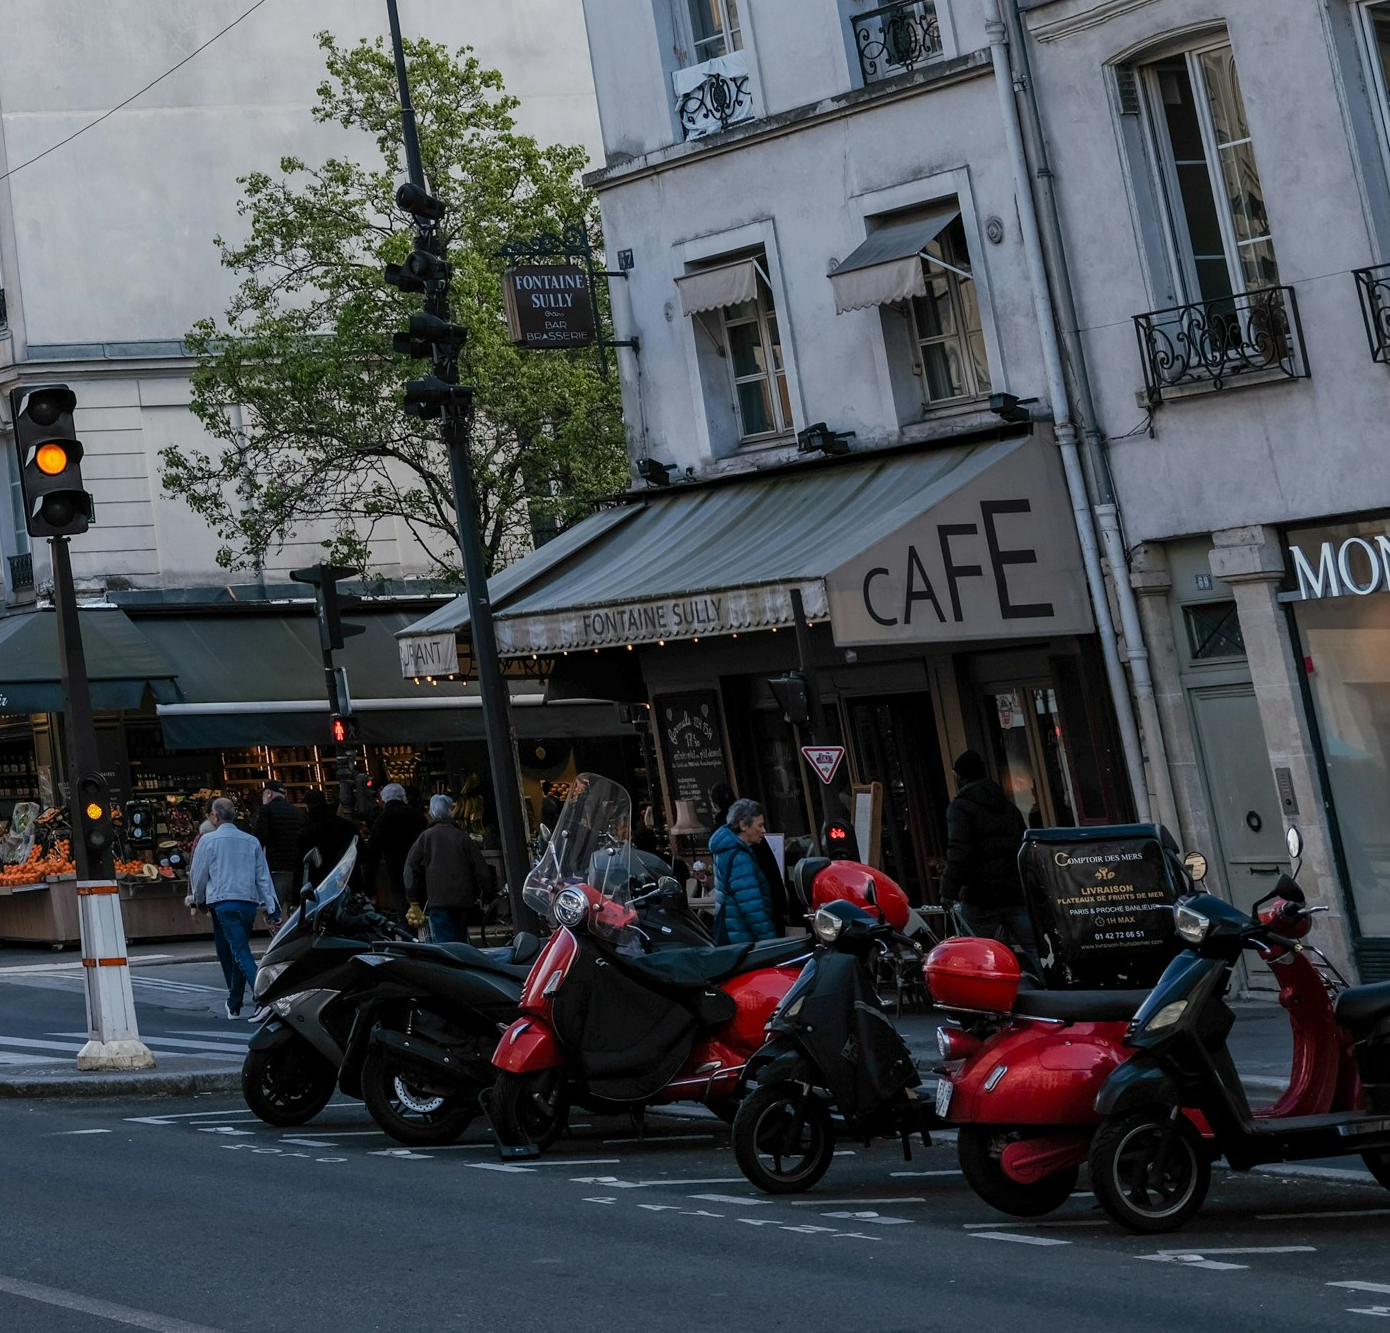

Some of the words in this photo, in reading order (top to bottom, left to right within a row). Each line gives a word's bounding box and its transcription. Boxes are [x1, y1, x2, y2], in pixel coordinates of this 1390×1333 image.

[515, 275, 584, 290] FONTAINE
[531, 293, 573, 308] SULLY
[545, 321, 567, 329] BAR
[527, 331, 588, 341] BRASSERIE
[862, 498, 1055, 629] CAFE
[1198, 577, 1209, 588] 69
[582, 604, 668, 634] FONTAINE
[673, 599, 722, 628] SULLY
[1054, 852, 1103, 867] COMPTOIR
[1121, 853, 1143, 861] MERS
[1081, 885, 1134, 895] LIVRAISON
[1057, 896, 1096, 905] PLATEAUX
[1108, 893, 1135, 901] FRUITS
[1096, 906, 1124, 914] PROCHE
[1125, 904, 1157, 912] BANLIEUE
[1118, 916, 1135, 924] MAX
[219, 1143, 348, 1162] MOTO
[580, 1196, 883, 1240] PAYANT
